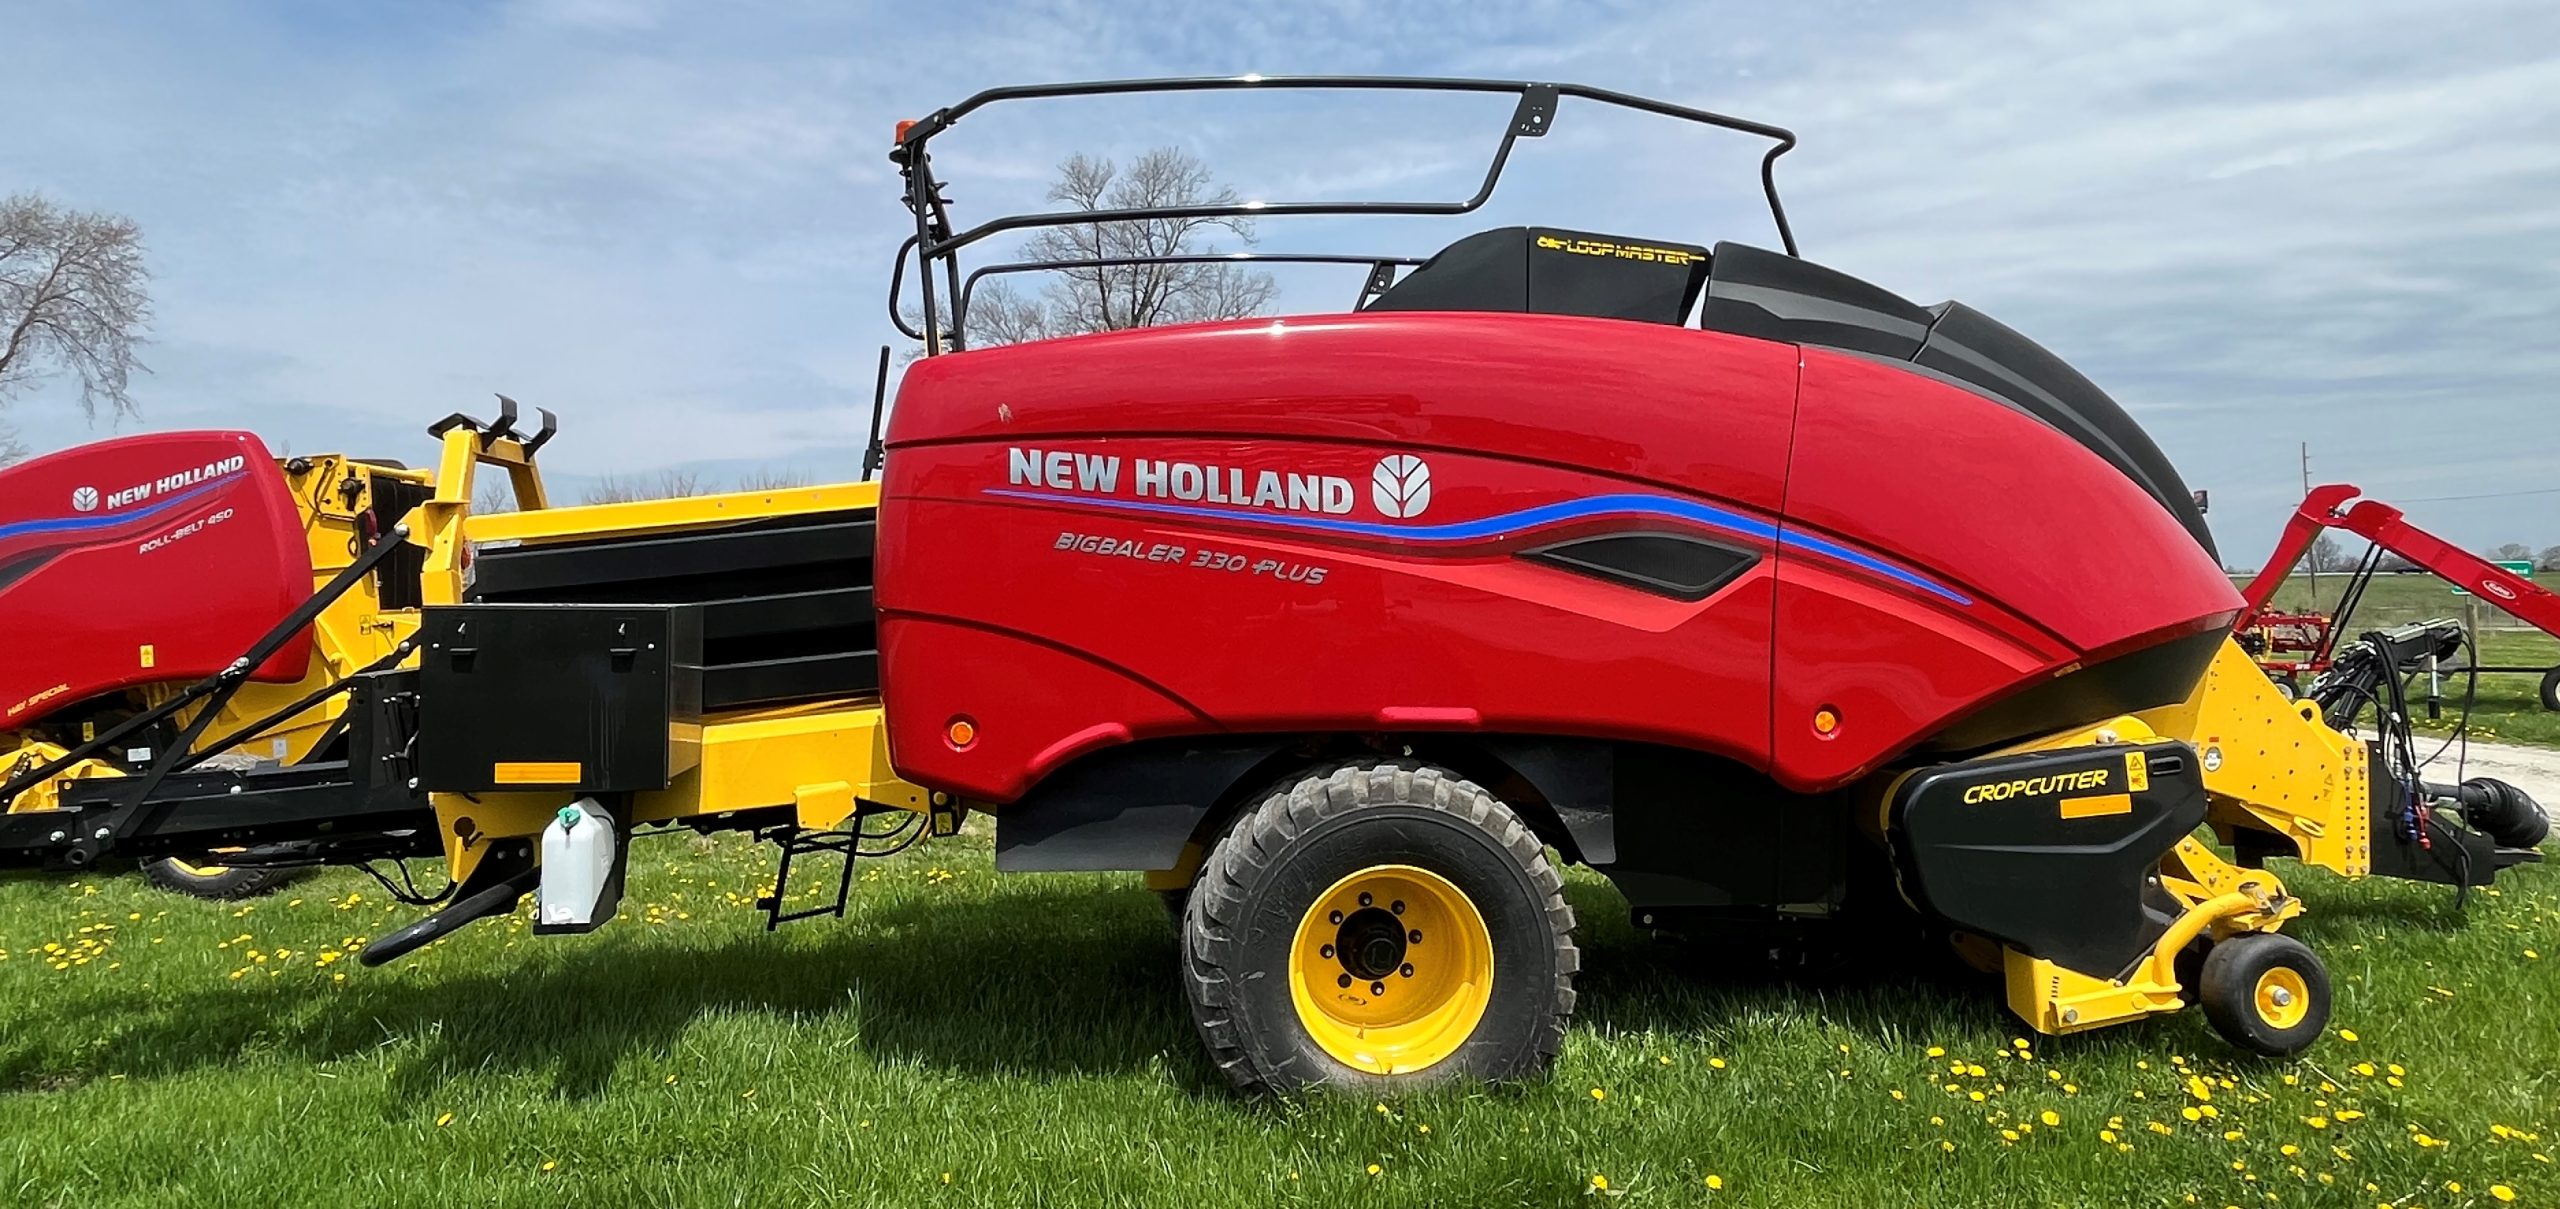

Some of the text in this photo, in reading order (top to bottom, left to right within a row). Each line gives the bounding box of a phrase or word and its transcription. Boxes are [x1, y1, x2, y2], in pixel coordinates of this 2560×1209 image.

[1566, 239, 1690, 266] LOOP MASTER
[107, 455, 244, 510] NEW HOLLAND
[1008, 447, 1355, 515] NEW HOLLAND
[139, 508, 234, 554] ROLL-BELT 450
[1054, 531, 1329, 586] BIGBALER 330 PLUS
[1963, 769, 2109, 805] CROPCUTTER
